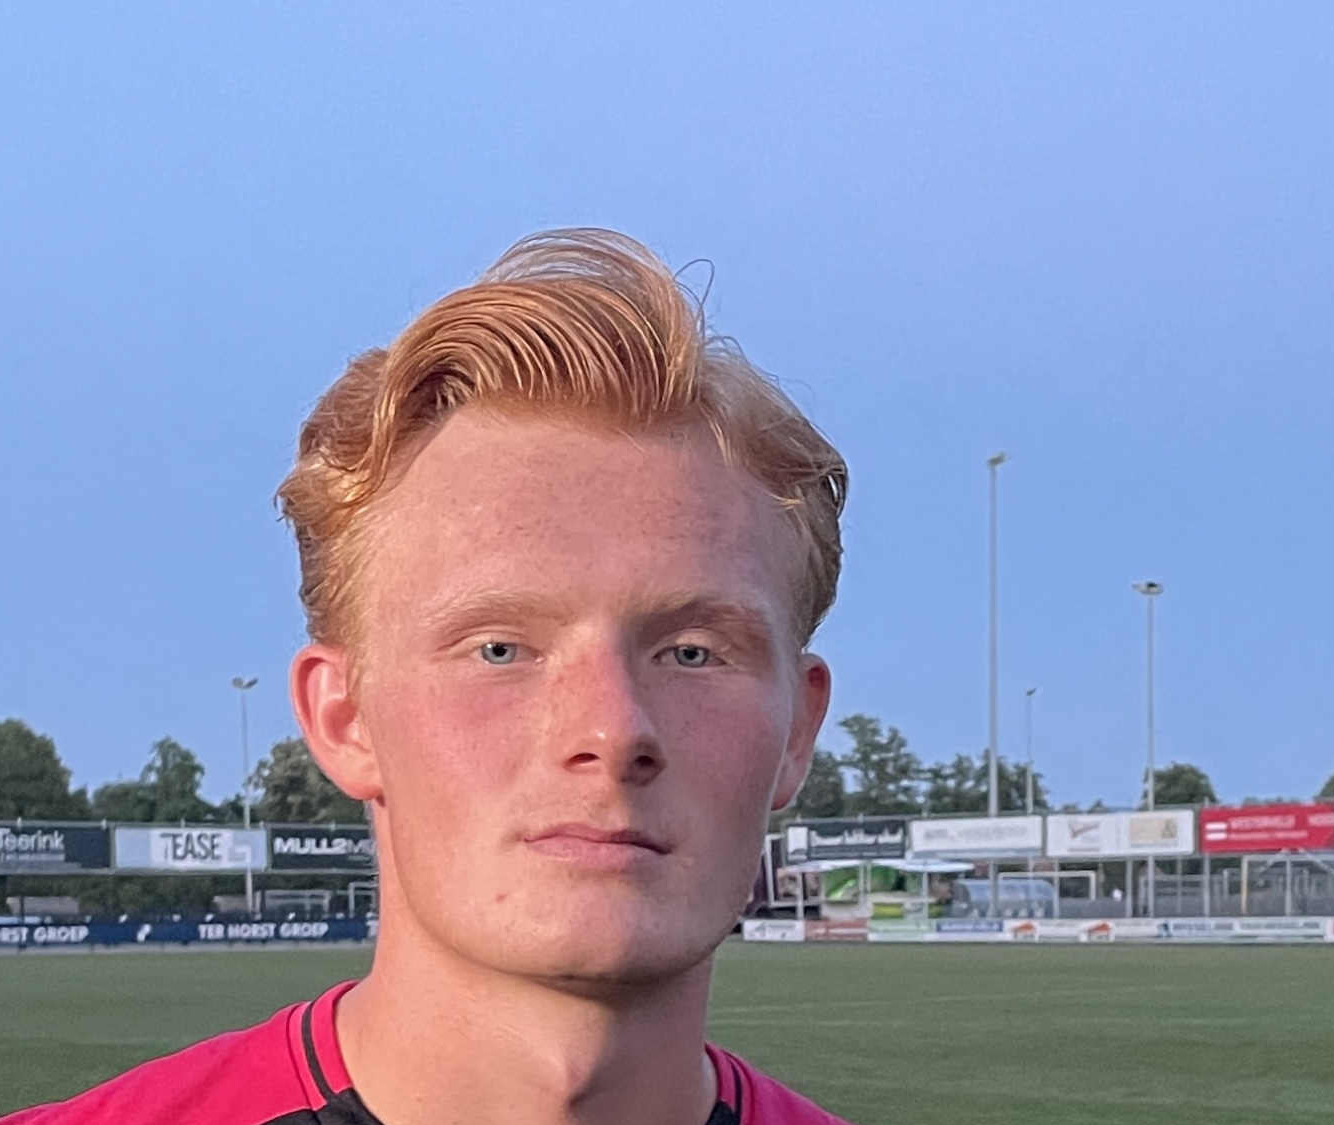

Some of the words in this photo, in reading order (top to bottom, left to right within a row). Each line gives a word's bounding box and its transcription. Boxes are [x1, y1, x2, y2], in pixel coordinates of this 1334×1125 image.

[273, 837, 374, 855] MULL2M
[34, 926, 90, 943] GROEP
[199, 924, 224, 940] TER
[228, 923, 276, 939] HORST
[280, 922, 328, 938] GROEP
